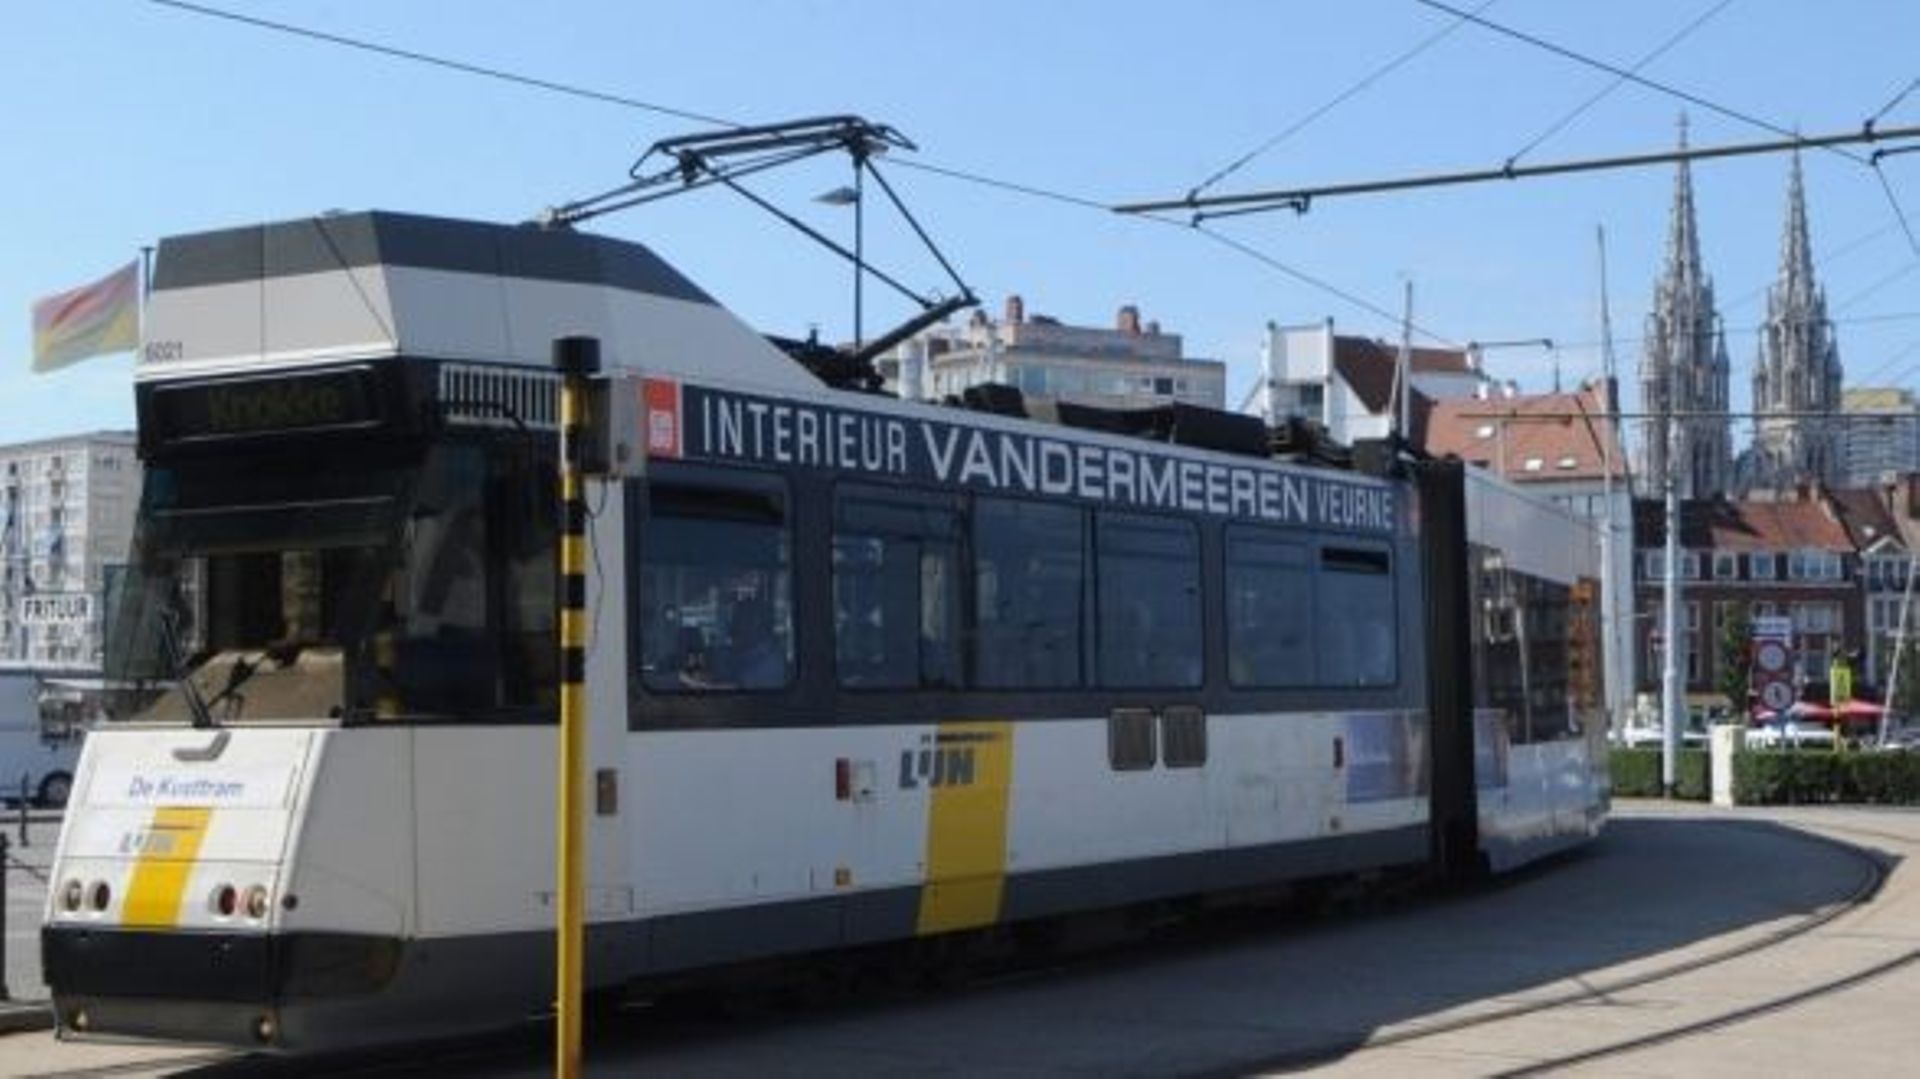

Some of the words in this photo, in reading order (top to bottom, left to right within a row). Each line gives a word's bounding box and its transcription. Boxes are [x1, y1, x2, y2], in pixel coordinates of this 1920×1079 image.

[703, 396, 906, 473] INTERIEUR
[920, 423, 1309, 523] VANDERMEEREN
[1316, 481, 1395, 530] VEURNE
[24, 597, 89, 619] FRITUUR
[129, 775, 153, 798] De
[156, 779, 244, 798] Kusttram
